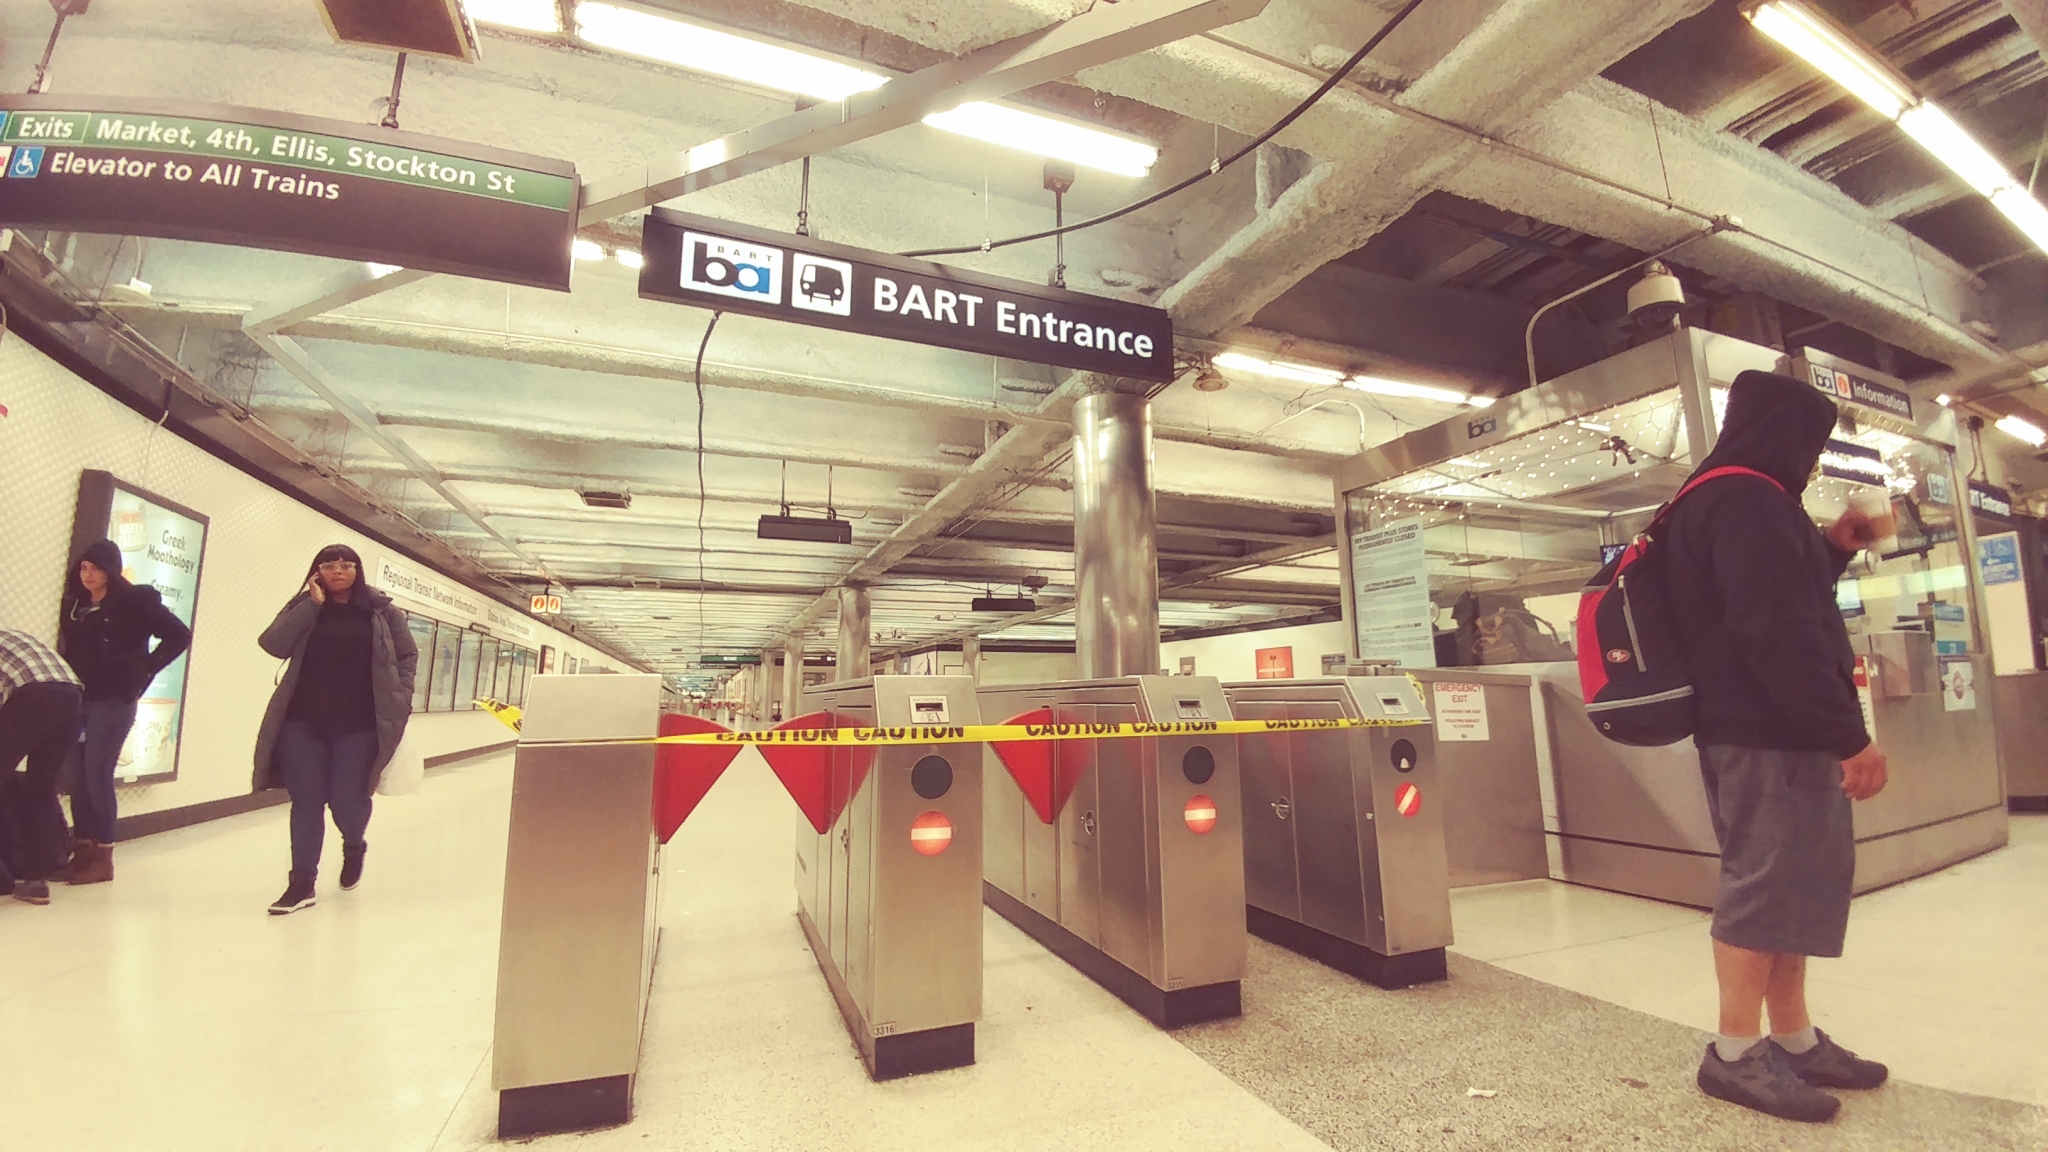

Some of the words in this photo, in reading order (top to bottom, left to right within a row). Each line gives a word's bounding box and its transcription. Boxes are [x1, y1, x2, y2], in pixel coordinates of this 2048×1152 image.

[18, 116, 74, 139] Exits
[97, 118, 197, 149] Market,
[205, 127, 261, 156] 4th,
[271, 134, 336, 166] Ellis,
[346, 146, 477, 187] Stockton
[486, 170, 516, 194] St
[50, 151, 157, 179] Elevator
[163, 159, 193, 182] to
[200, 162, 242, 188] All
[250, 167, 341, 201] Trains
[716, 245, 774, 263] BART
[873, 276, 984, 327] BART
[996, 300, 1154, 359] Entrance
[1852, 379, 1910, 414] Information
[161, 529, 187, 552] Greek
[1395, 532, 1415, 542] CLOSED
[146, 543, 197, 576] Moothology
[382, 564, 414, 589] Regional
[413, 577, 433, 599] Transit
[432, 584, 455, 607] Network
[1436, 683, 1482, 692] EMERGENCY
[1452, 694, 1468, 703] EXIT
[716, 729, 839, 742] CAUTION
[853, 726, 965, 741] CAUTION
[1026, 723, 1121, 737] CAUTION
[1132, 721, 1218, 733] CAUTION
